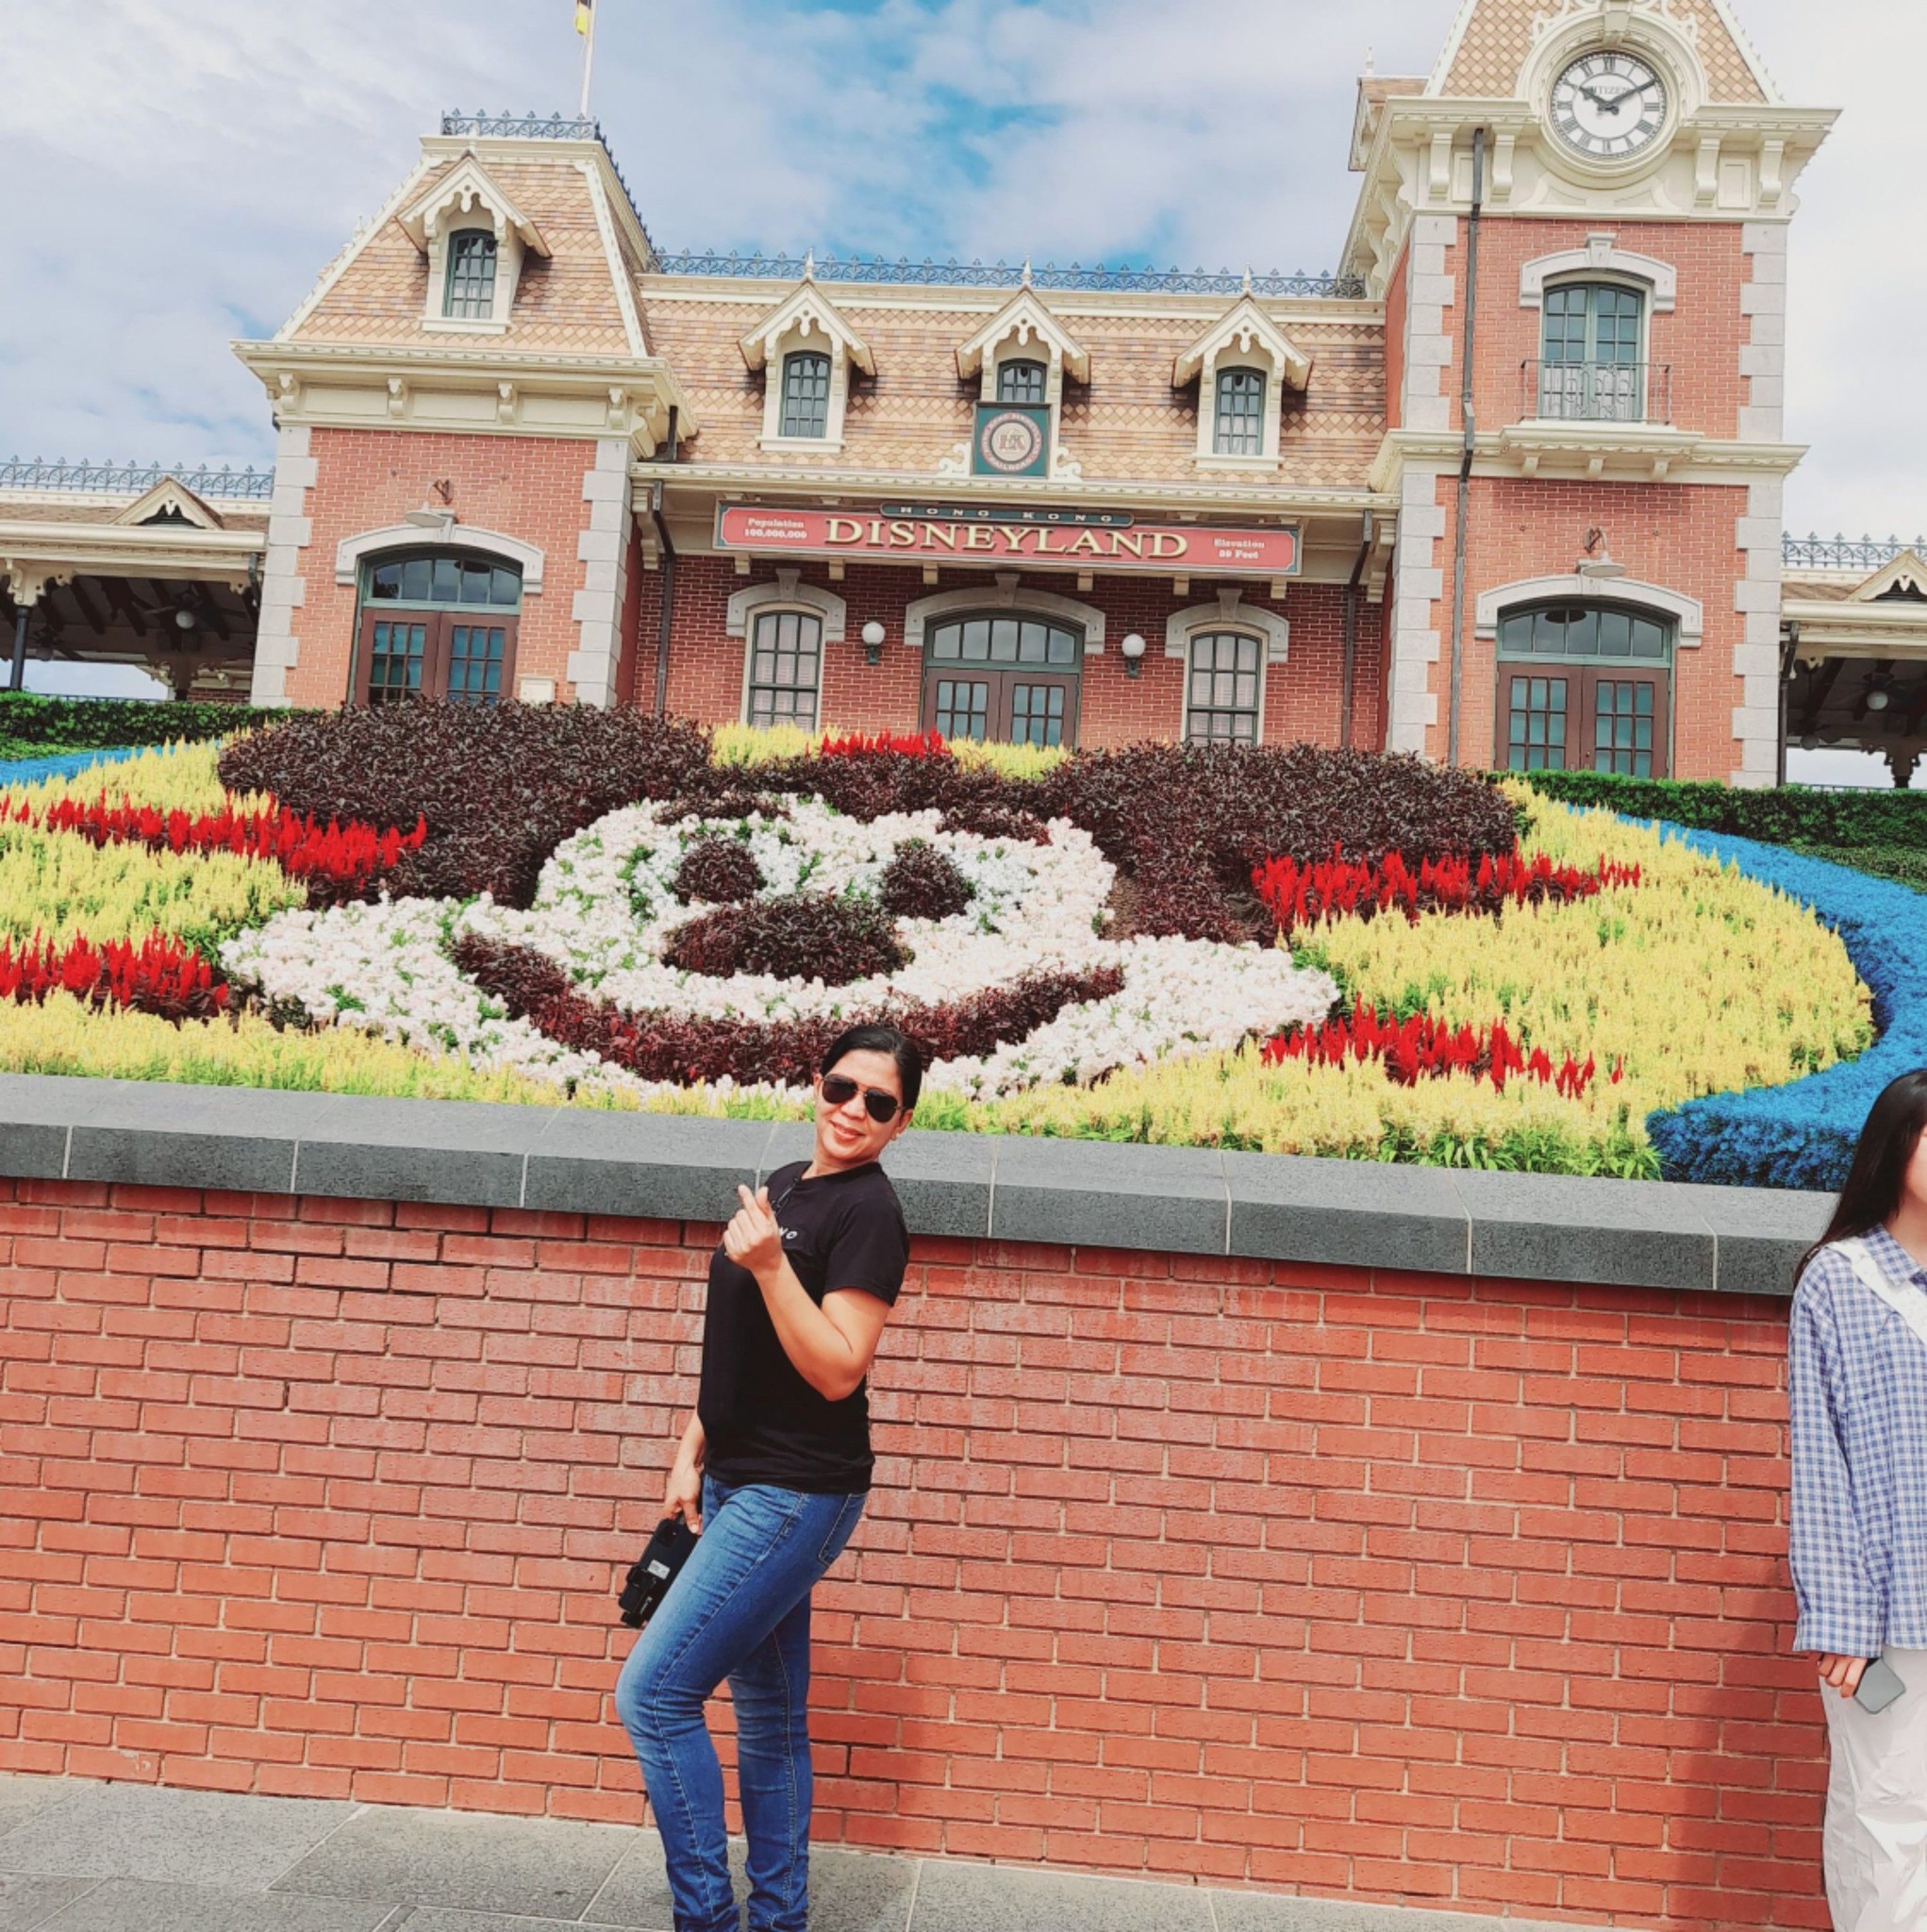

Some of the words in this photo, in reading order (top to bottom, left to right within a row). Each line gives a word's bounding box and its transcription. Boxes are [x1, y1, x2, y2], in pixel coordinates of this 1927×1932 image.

[900, 506, 989, 518] HONG
[1022, 511, 1112, 522] KONG
[748, 518, 804, 528] Population
[824, 518, 1188, 558] DISNEYLAND
[1214, 538, 1265, 549] Elevation
[1235, 549, 1259, 559] Feet
